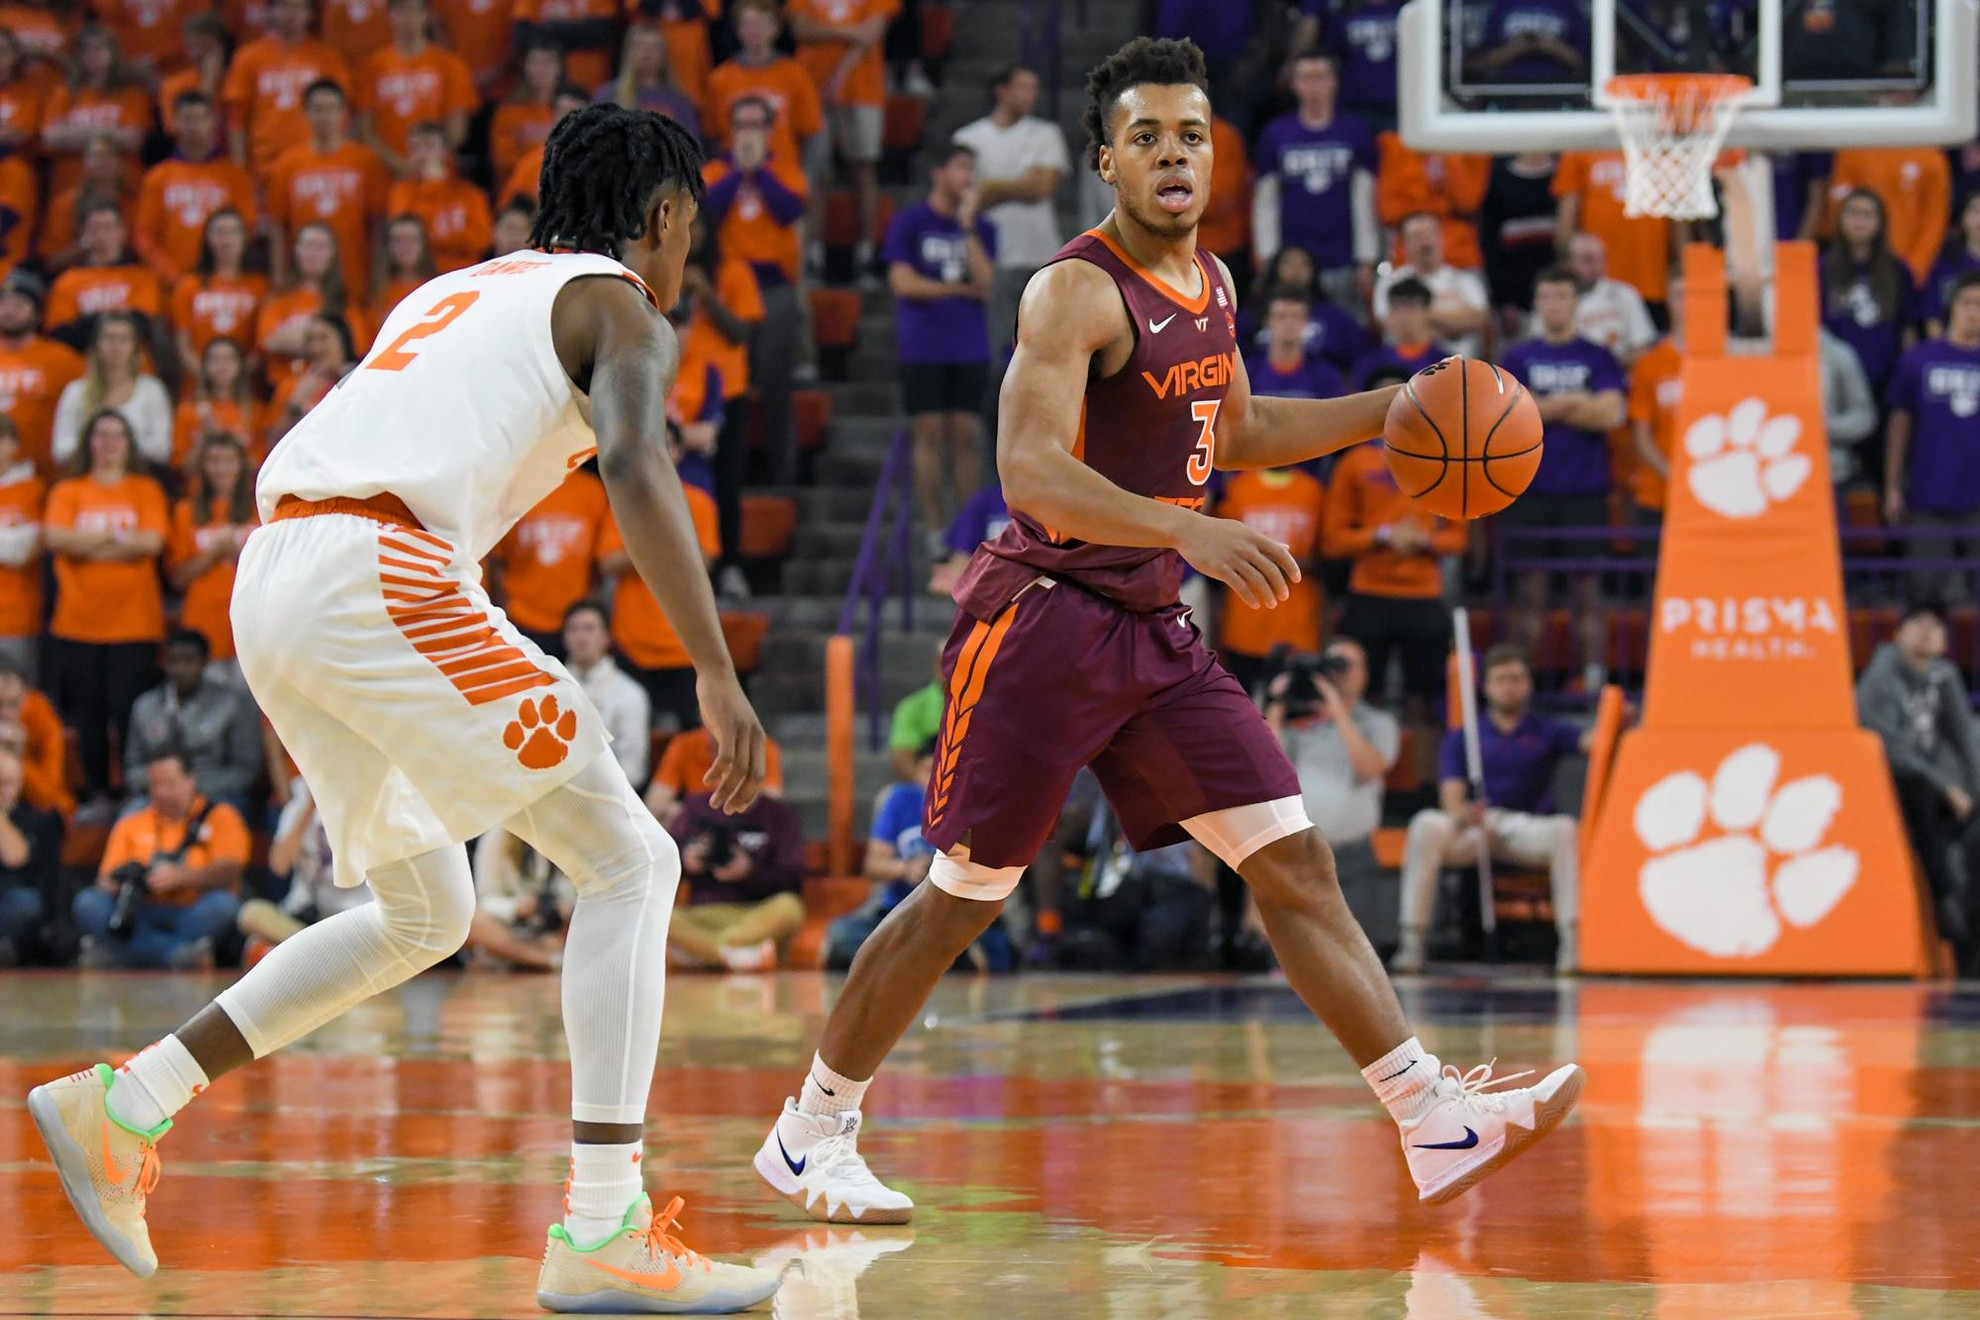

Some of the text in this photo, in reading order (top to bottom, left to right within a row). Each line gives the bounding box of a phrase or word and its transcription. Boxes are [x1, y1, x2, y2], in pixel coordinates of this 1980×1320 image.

[364, 290, 481, 372] 2
[1186, 399, 1222, 486] 3
[1662, 597, 1838, 634] PRISMA
